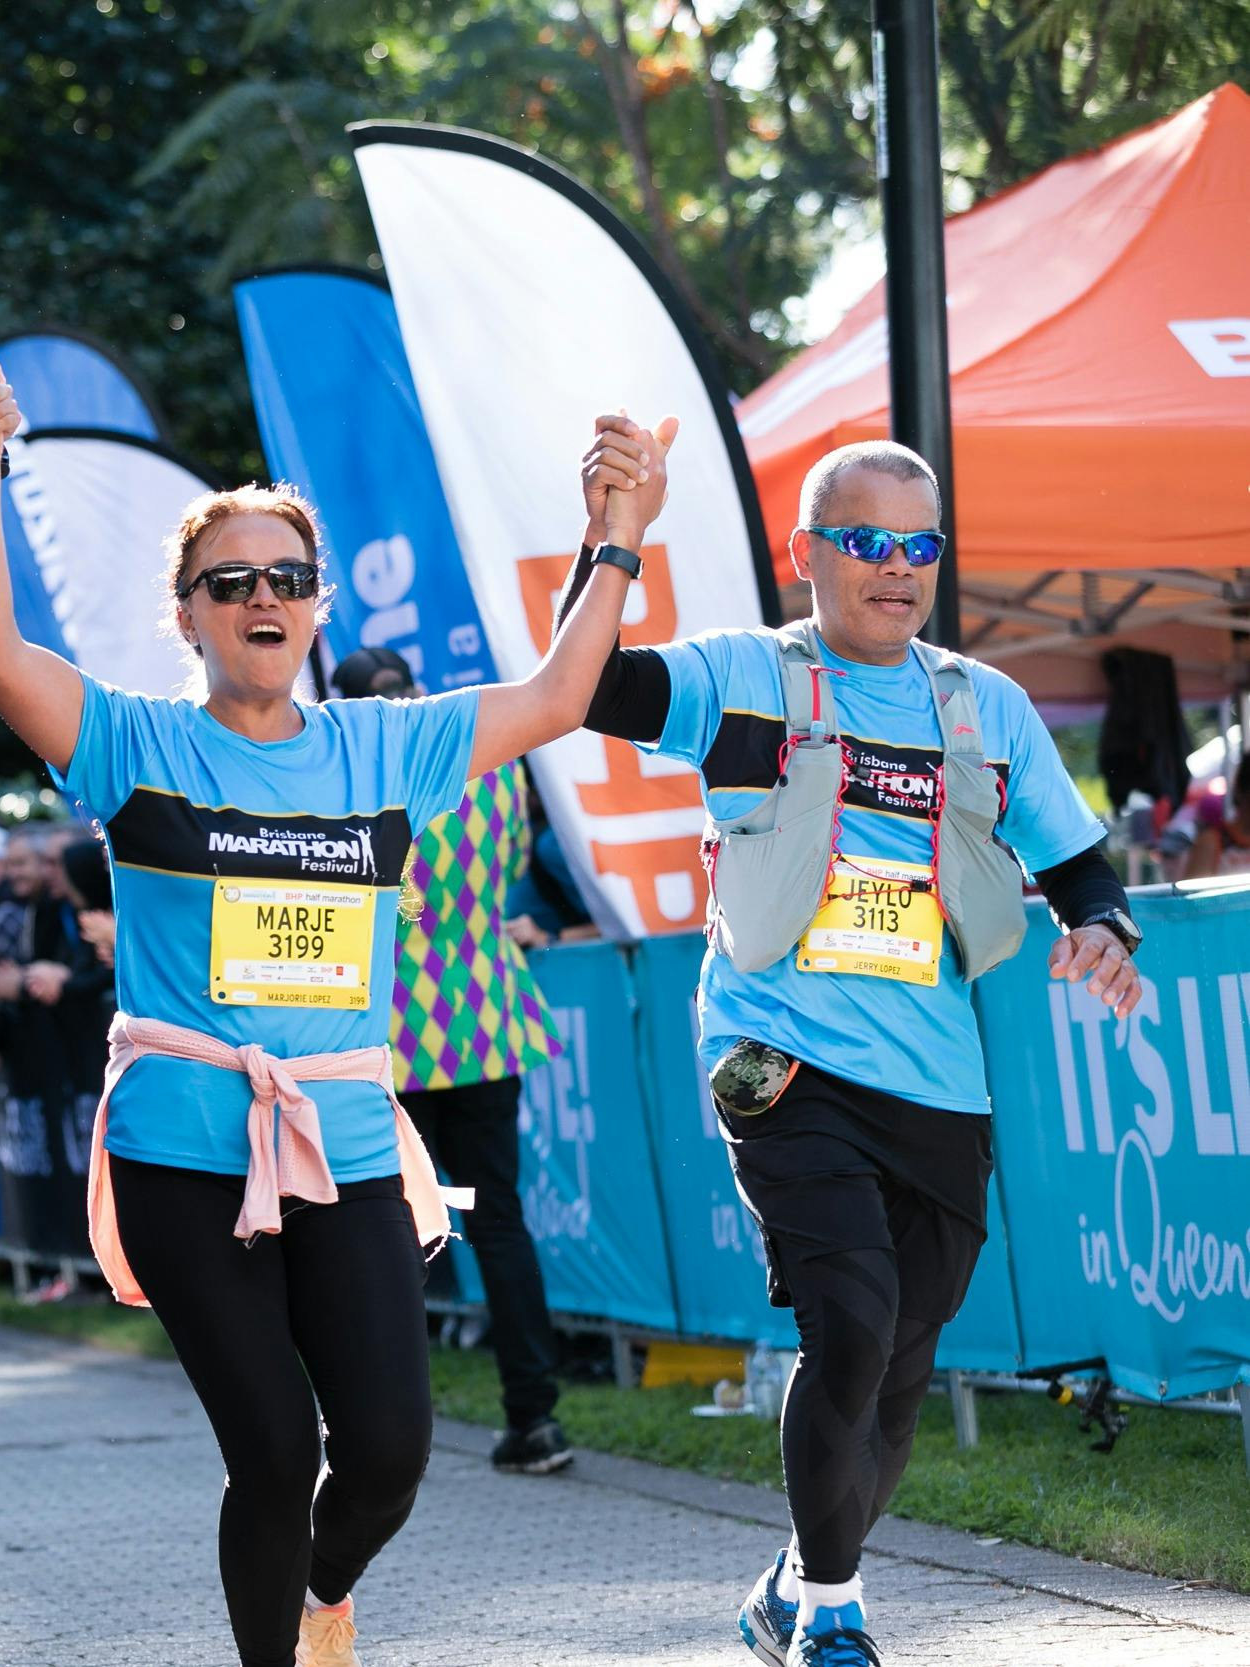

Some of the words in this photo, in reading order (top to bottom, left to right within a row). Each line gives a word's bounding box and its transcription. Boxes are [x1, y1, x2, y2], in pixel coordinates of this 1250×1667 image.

[259, 827, 326, 840] Brisbane
[208, 832, 360, 860] MARATHON
[301, 858, 359, 875] Festival
[885, 869, 900, 879] half
[285, 892, 303, 901] BHP
[305, 893, 321, 903] half
[322, 894, 361, 904] marathon
[842, 879, 912, 909] JEYLO
[257, 906, 335, 933] MARJE
[853, 905, 899, 933] 3113
[268, 934, 324, 960] 3199
[853, 961, 878, 972] JERRY
[880, 964, 901, 976] LOPEZ
[267, 993, 307, 1003] MARJORIE
[309, 994, 331, 1004] LOPEZ
[349, 996, 365, 1005] 3199
[1047, 974, 1175, 1158] IT'S
[1177, 972, 1250, 1157] LI
[1078, 1213, 1118, 1289] in
